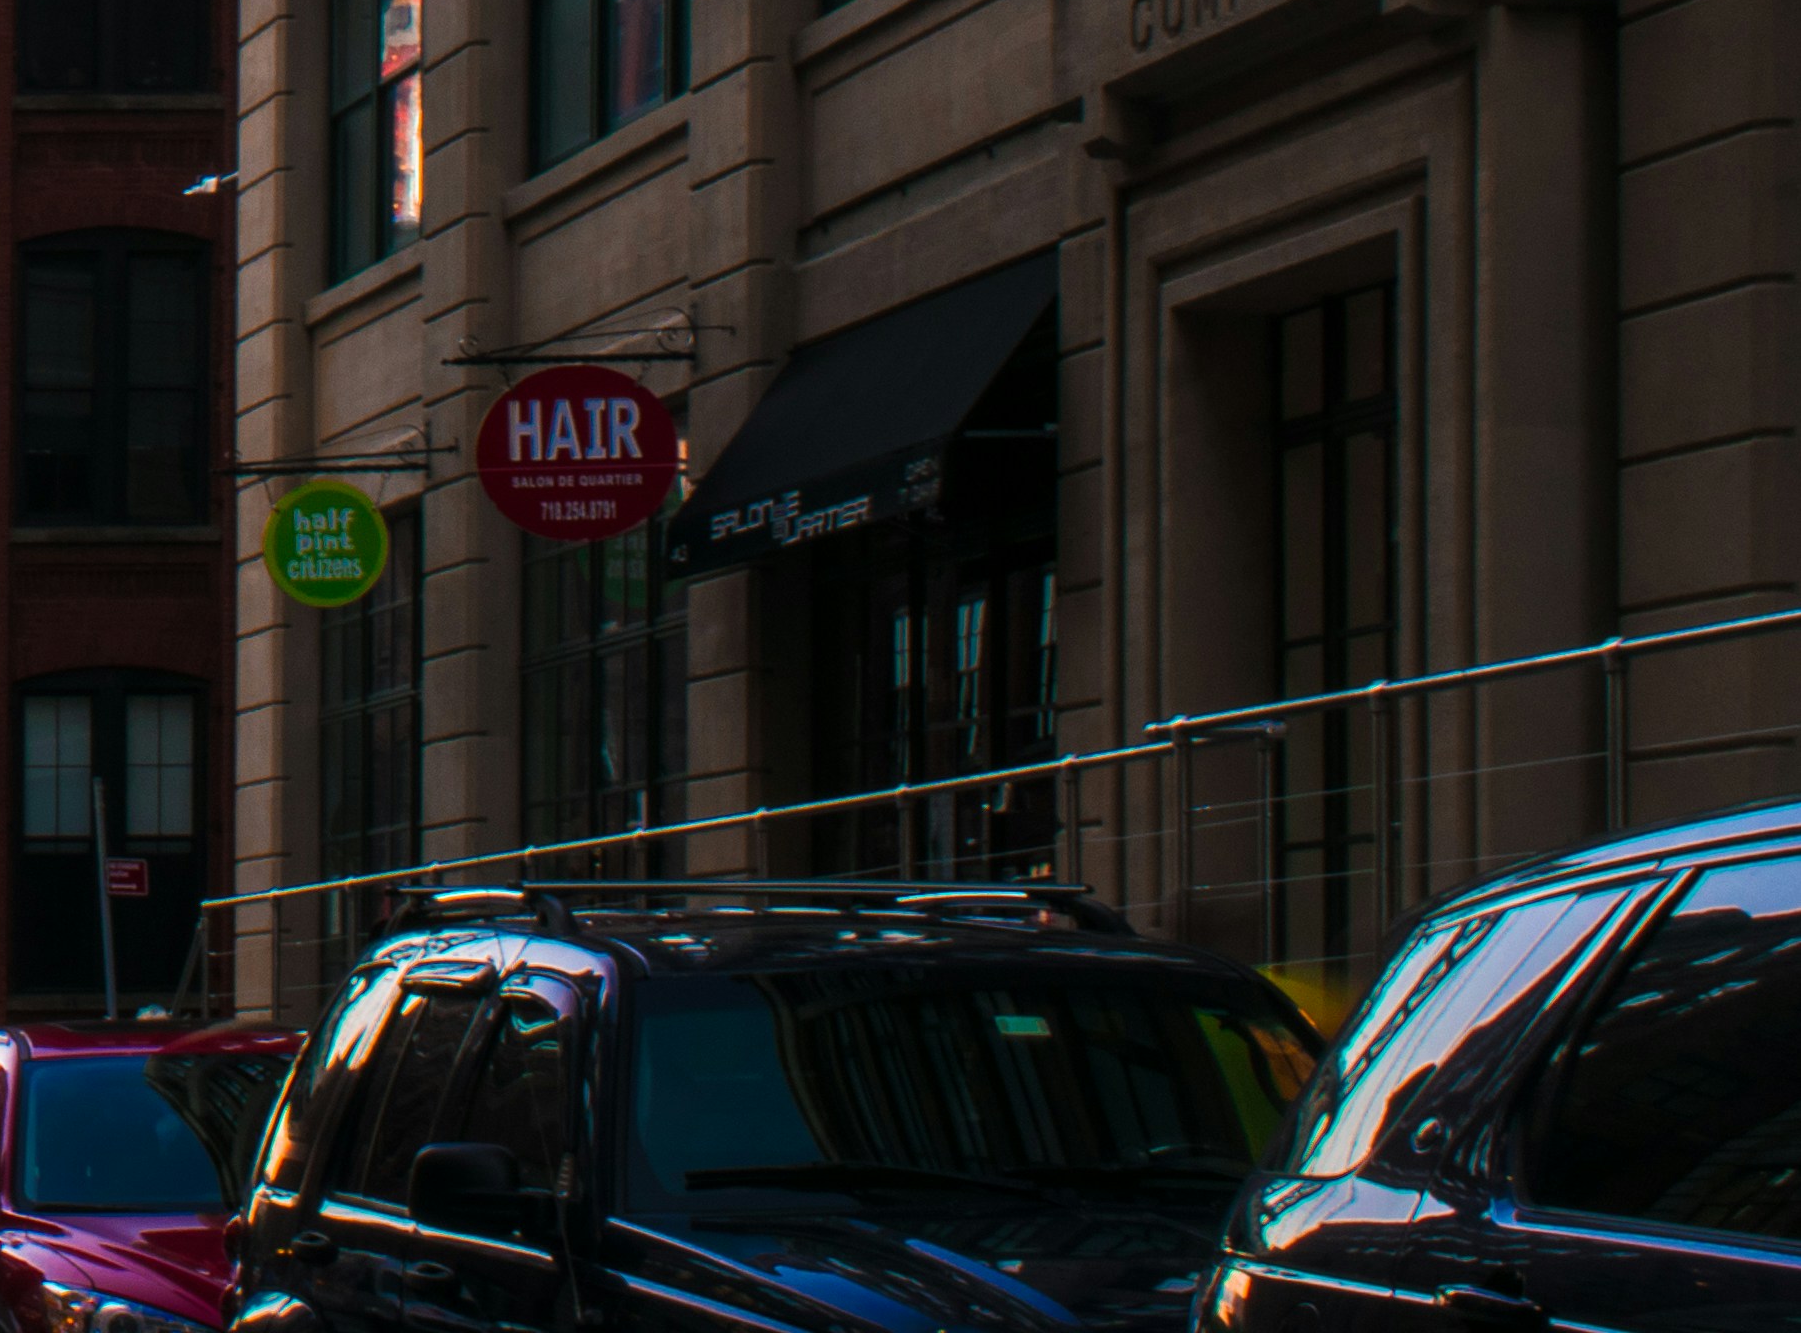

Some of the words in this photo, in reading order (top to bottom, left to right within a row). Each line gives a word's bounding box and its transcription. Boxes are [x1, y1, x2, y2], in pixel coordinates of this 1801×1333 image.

[506, 396, 644, 463] HAIR
[511, 474, 555, 489] SALON
[557, 474, 575, 487] DE
[578, 473, 644, 487] QUARTIER
[293, 506, 355, 532] half
[295, 531, 354, 556] pint
[287, 552, 363, 580] citizens
